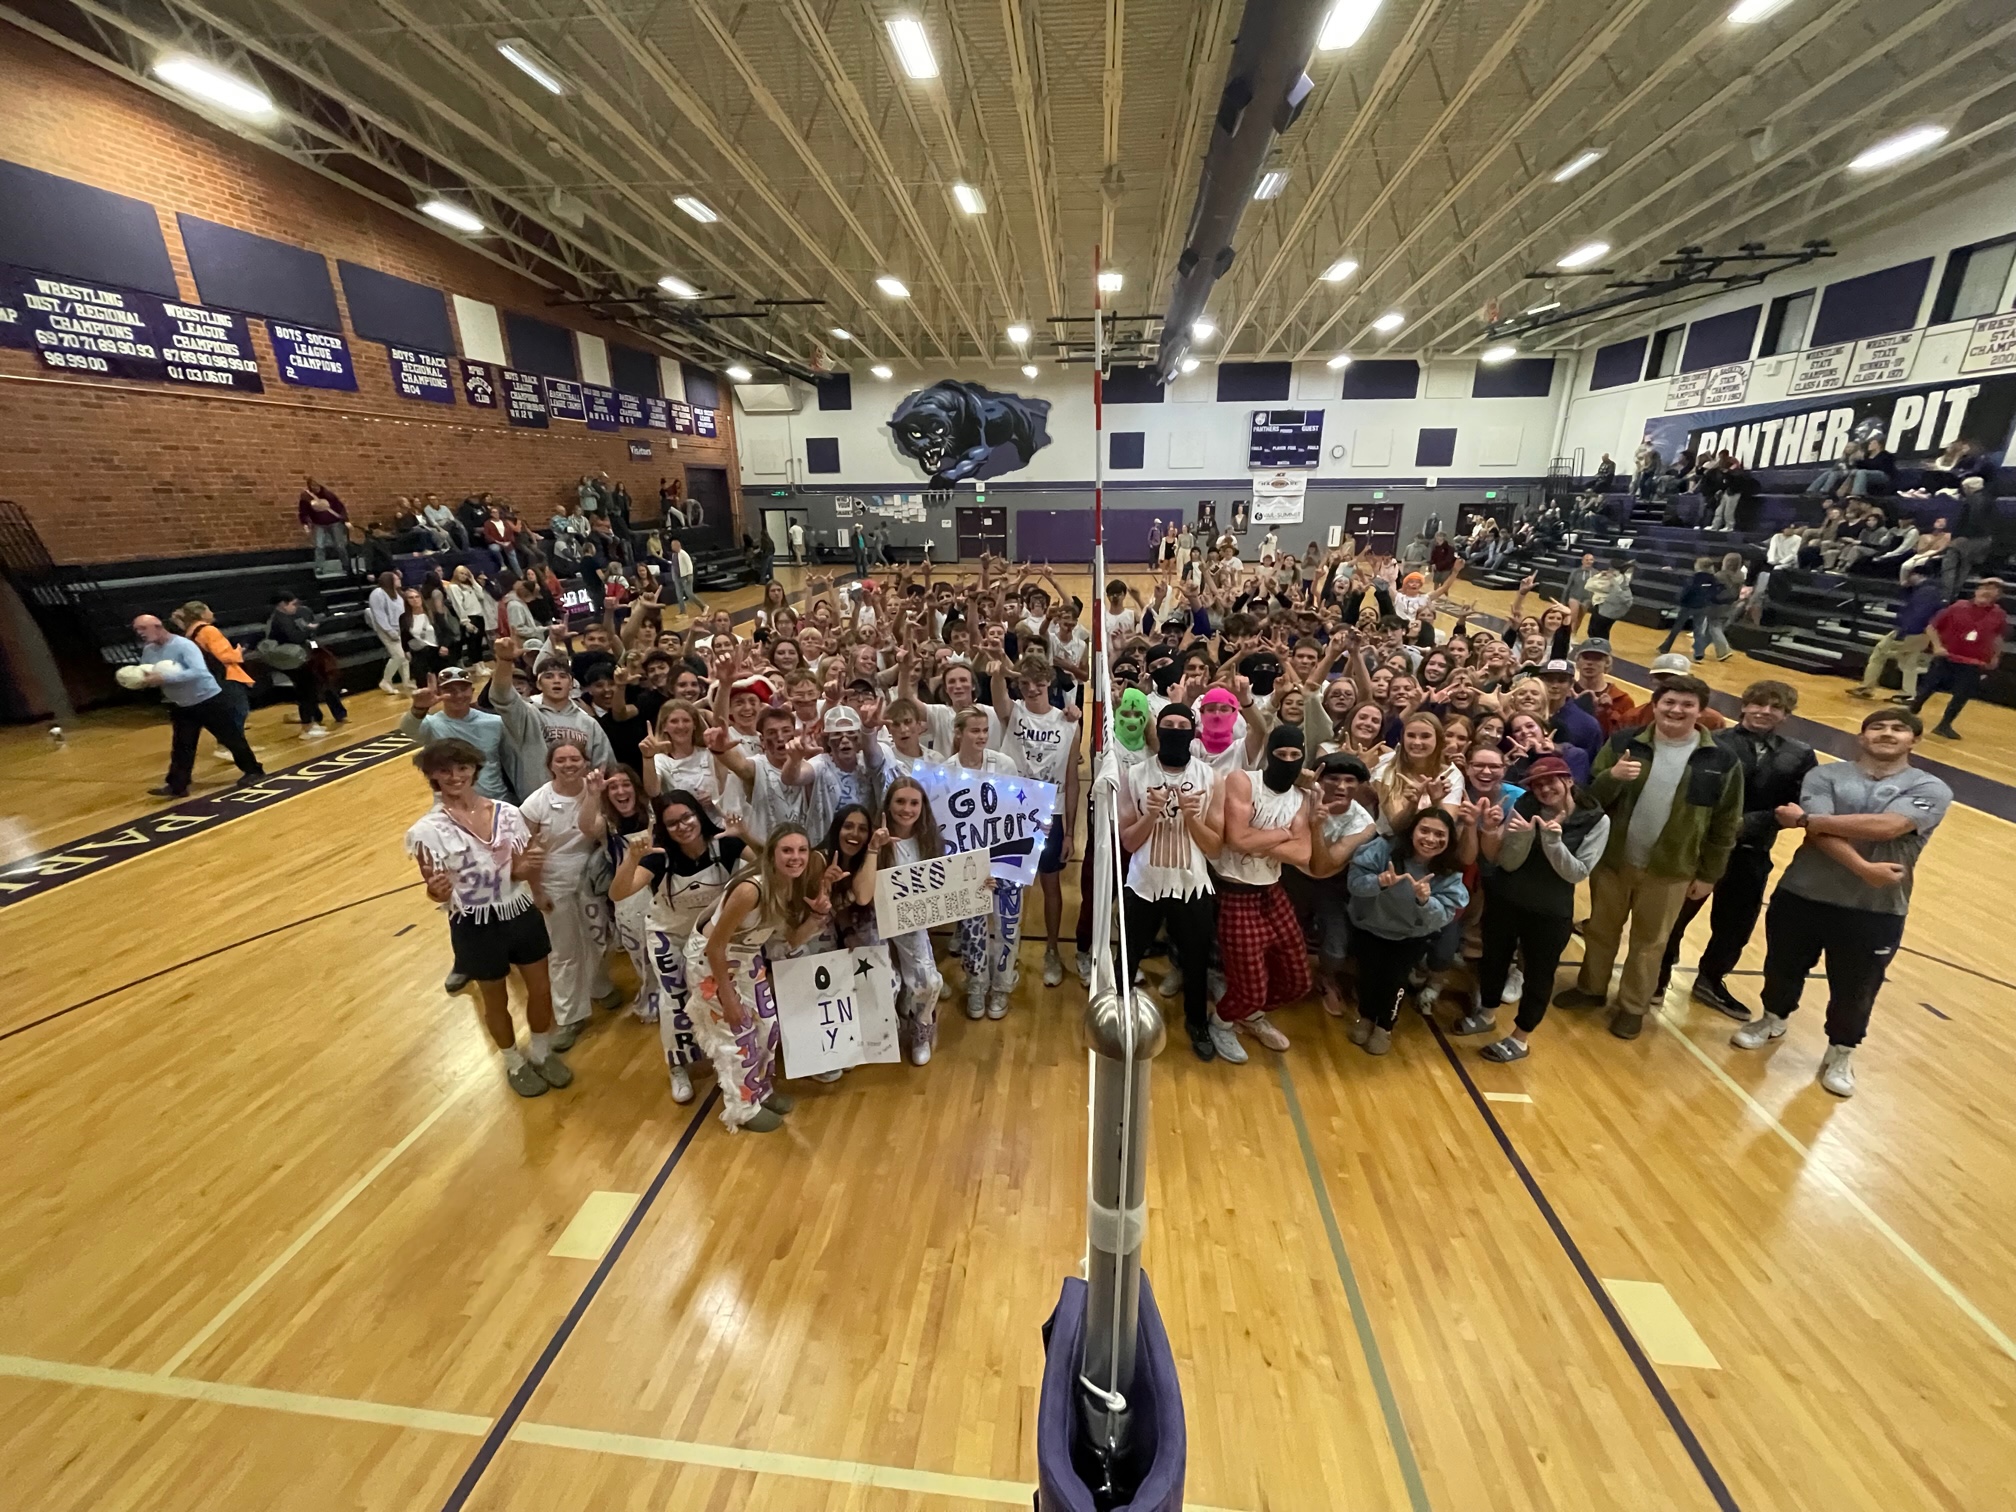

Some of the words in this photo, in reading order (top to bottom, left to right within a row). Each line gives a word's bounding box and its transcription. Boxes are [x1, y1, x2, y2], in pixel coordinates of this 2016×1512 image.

[35, 278, 124, 308] WRESTLING
[23, 293, 64, 314] DIST
[74, 302, 146, 327] REGIONAL
[162, 303, 233, 328] WRESTLING
[49, 315, 134, 340] CHAMPIONS
[177, 320, 228, 340] LEAGUE
[1976, 316, 2016, 332] WRES
[58, 333, 80, 348] 70
[80, 336, 98, 351] 71
[172, 334, 240, 356] CHAMPIONS
[275, 326, 302, 342] BOYS
[305, 333, 342, 349] SOCCER
[1865, 334, 1913, 350] WRESTLING
[294, 343, 332, 360] LEAGUE
[391, 348, 415, 362] BOYS
[418, 354, 447, 368] TRACK
[1806, 346, 1845, 360] WRESTLING
[1872, 347, 1898, 359] STATE
[1990, 352, 2016, 365] 200
[89, 356, 108, 371] 00
[243, 360, 258, 373] 00
[289, 354, 343, 373] CHAMPIONS
[401, 361, 443, 377] REGIONAL
[1810, 358, 1833, 370] STATE
[167, 365, 184, 380] 01
[218, 372, 233, 385] 07
[401, 372, 447, 388] CHAMPIONS
[1799, 368, 1839, 381] CHAMPIONS
[1697, 407, 1855, 470] PANTHER
[1885, 384, 1981, 454] PIT
[948, 782, 998, 818] GO
[818, 996, 853, 1026] IN
